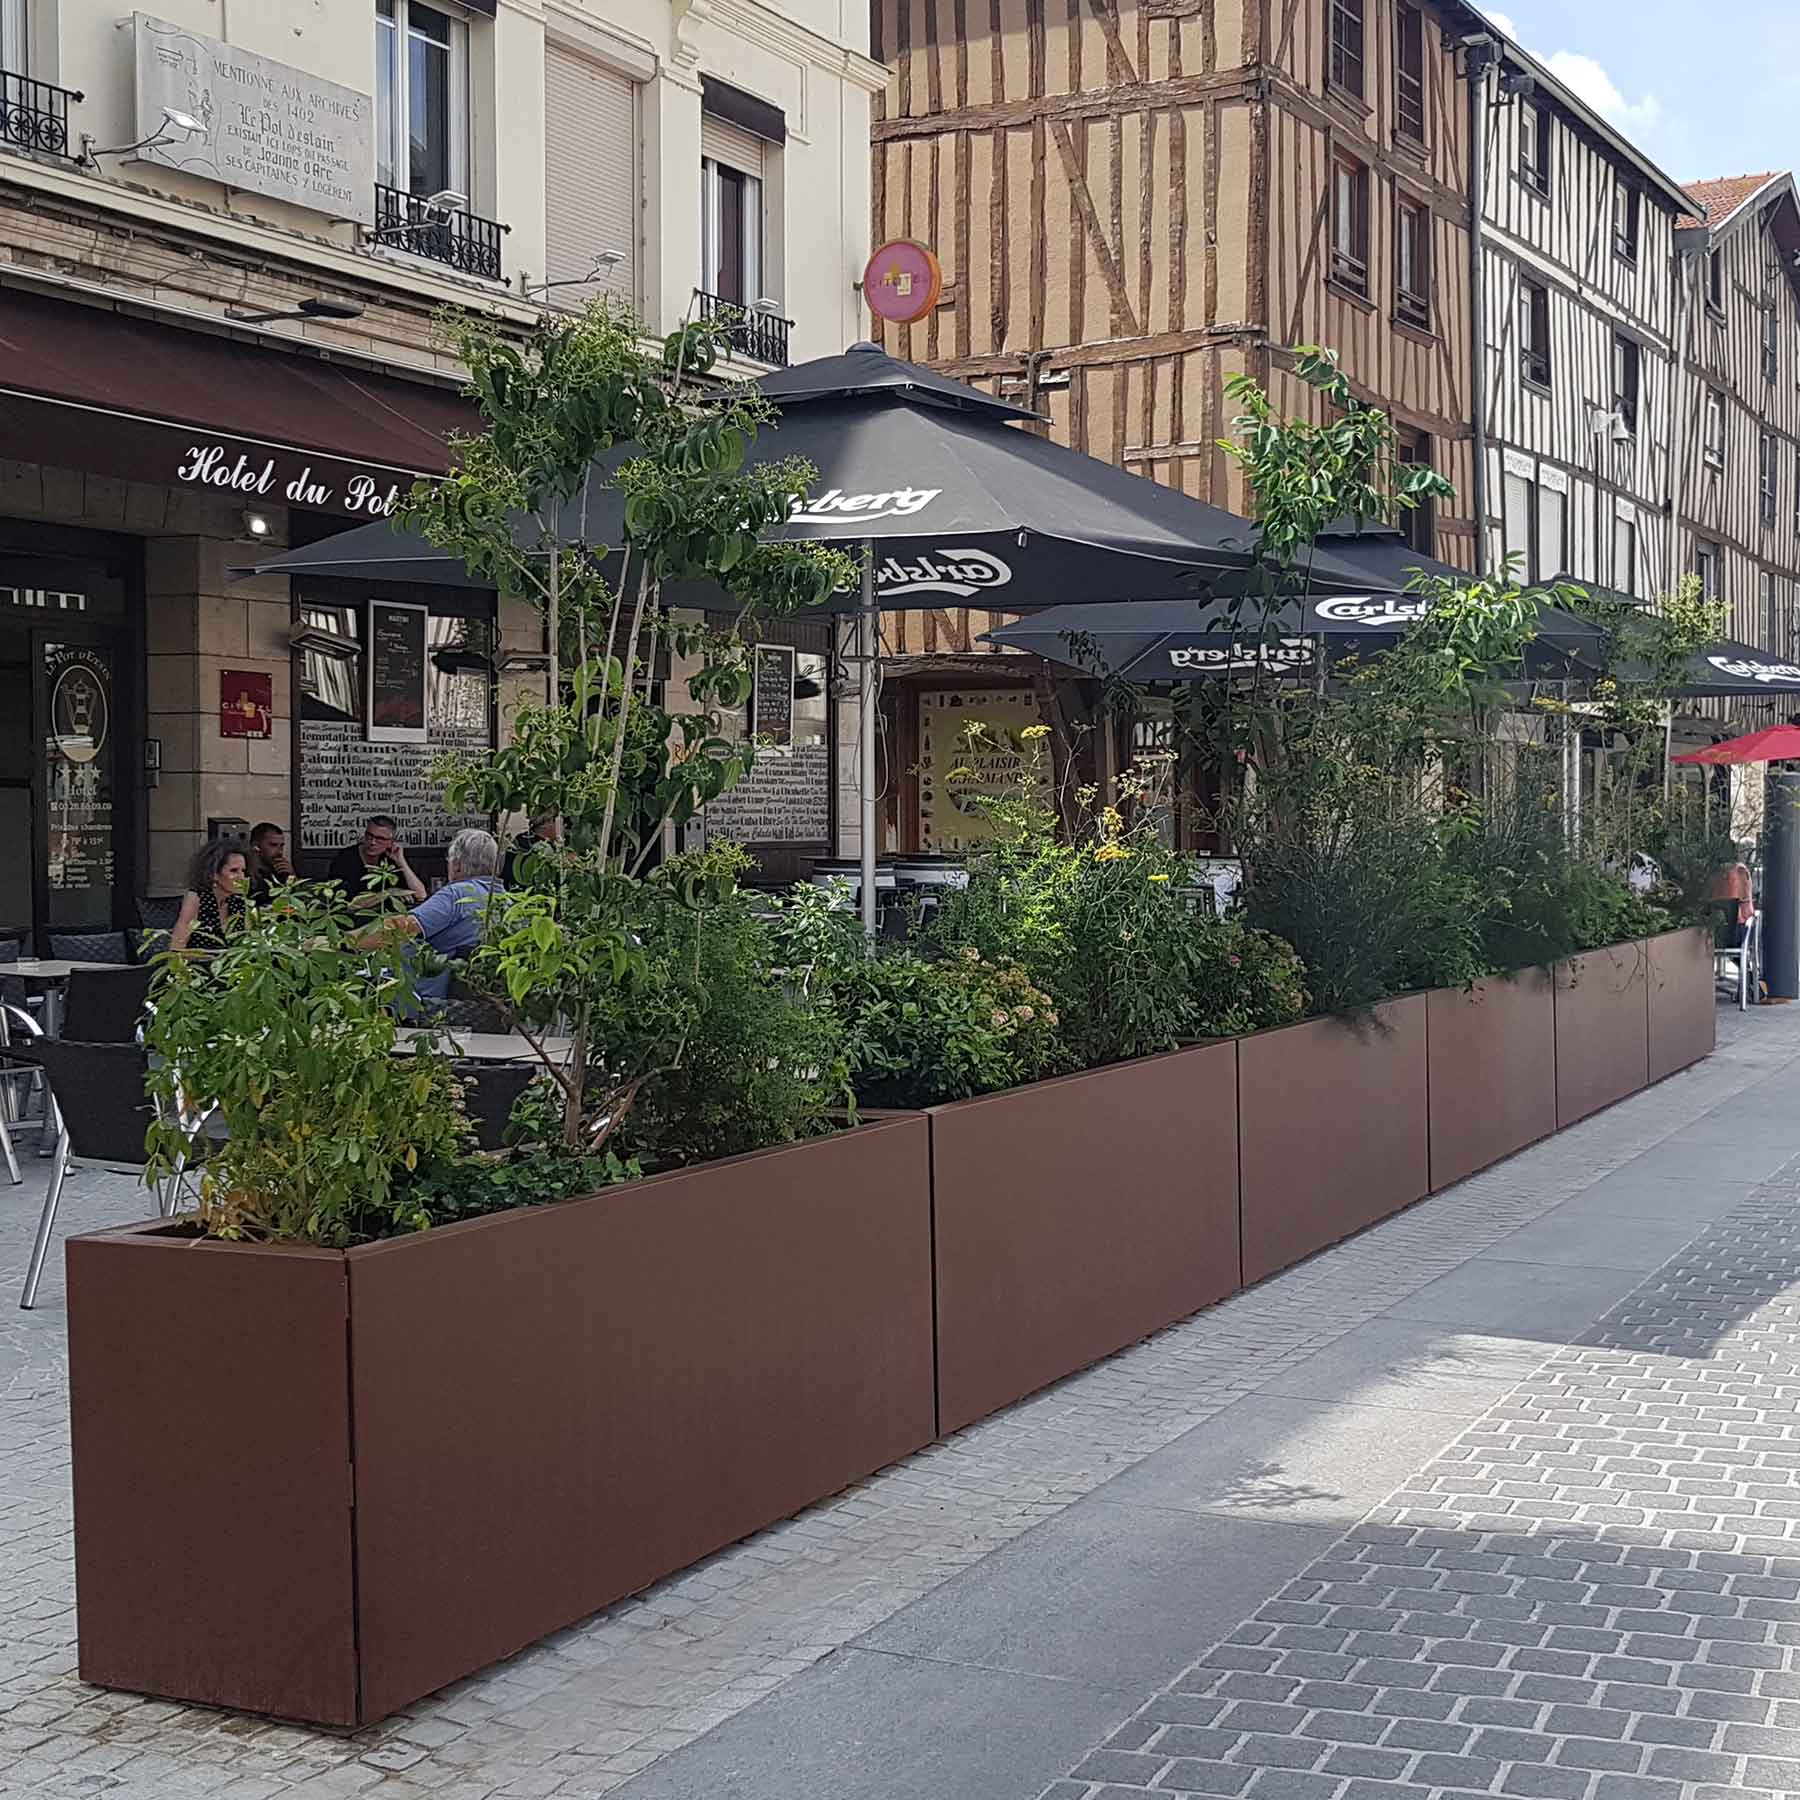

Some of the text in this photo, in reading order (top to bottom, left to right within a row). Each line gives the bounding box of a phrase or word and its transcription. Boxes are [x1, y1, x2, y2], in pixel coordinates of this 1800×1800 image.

[281, 84, 303, 103] AUX
[309, 93, 361, 123] ARCHIVES
[287, 103, 315, 124] 1402
[266, 136, 281, 152] ICI
[257, 147, 299, 170] Jeanne
[226, 155, 243, 171] SES
[244, 159, 298, 187] CAPITAINES
[178, 446, 399, 517] Hotel du Pot
[302, 829, 349, 848] Mojito
